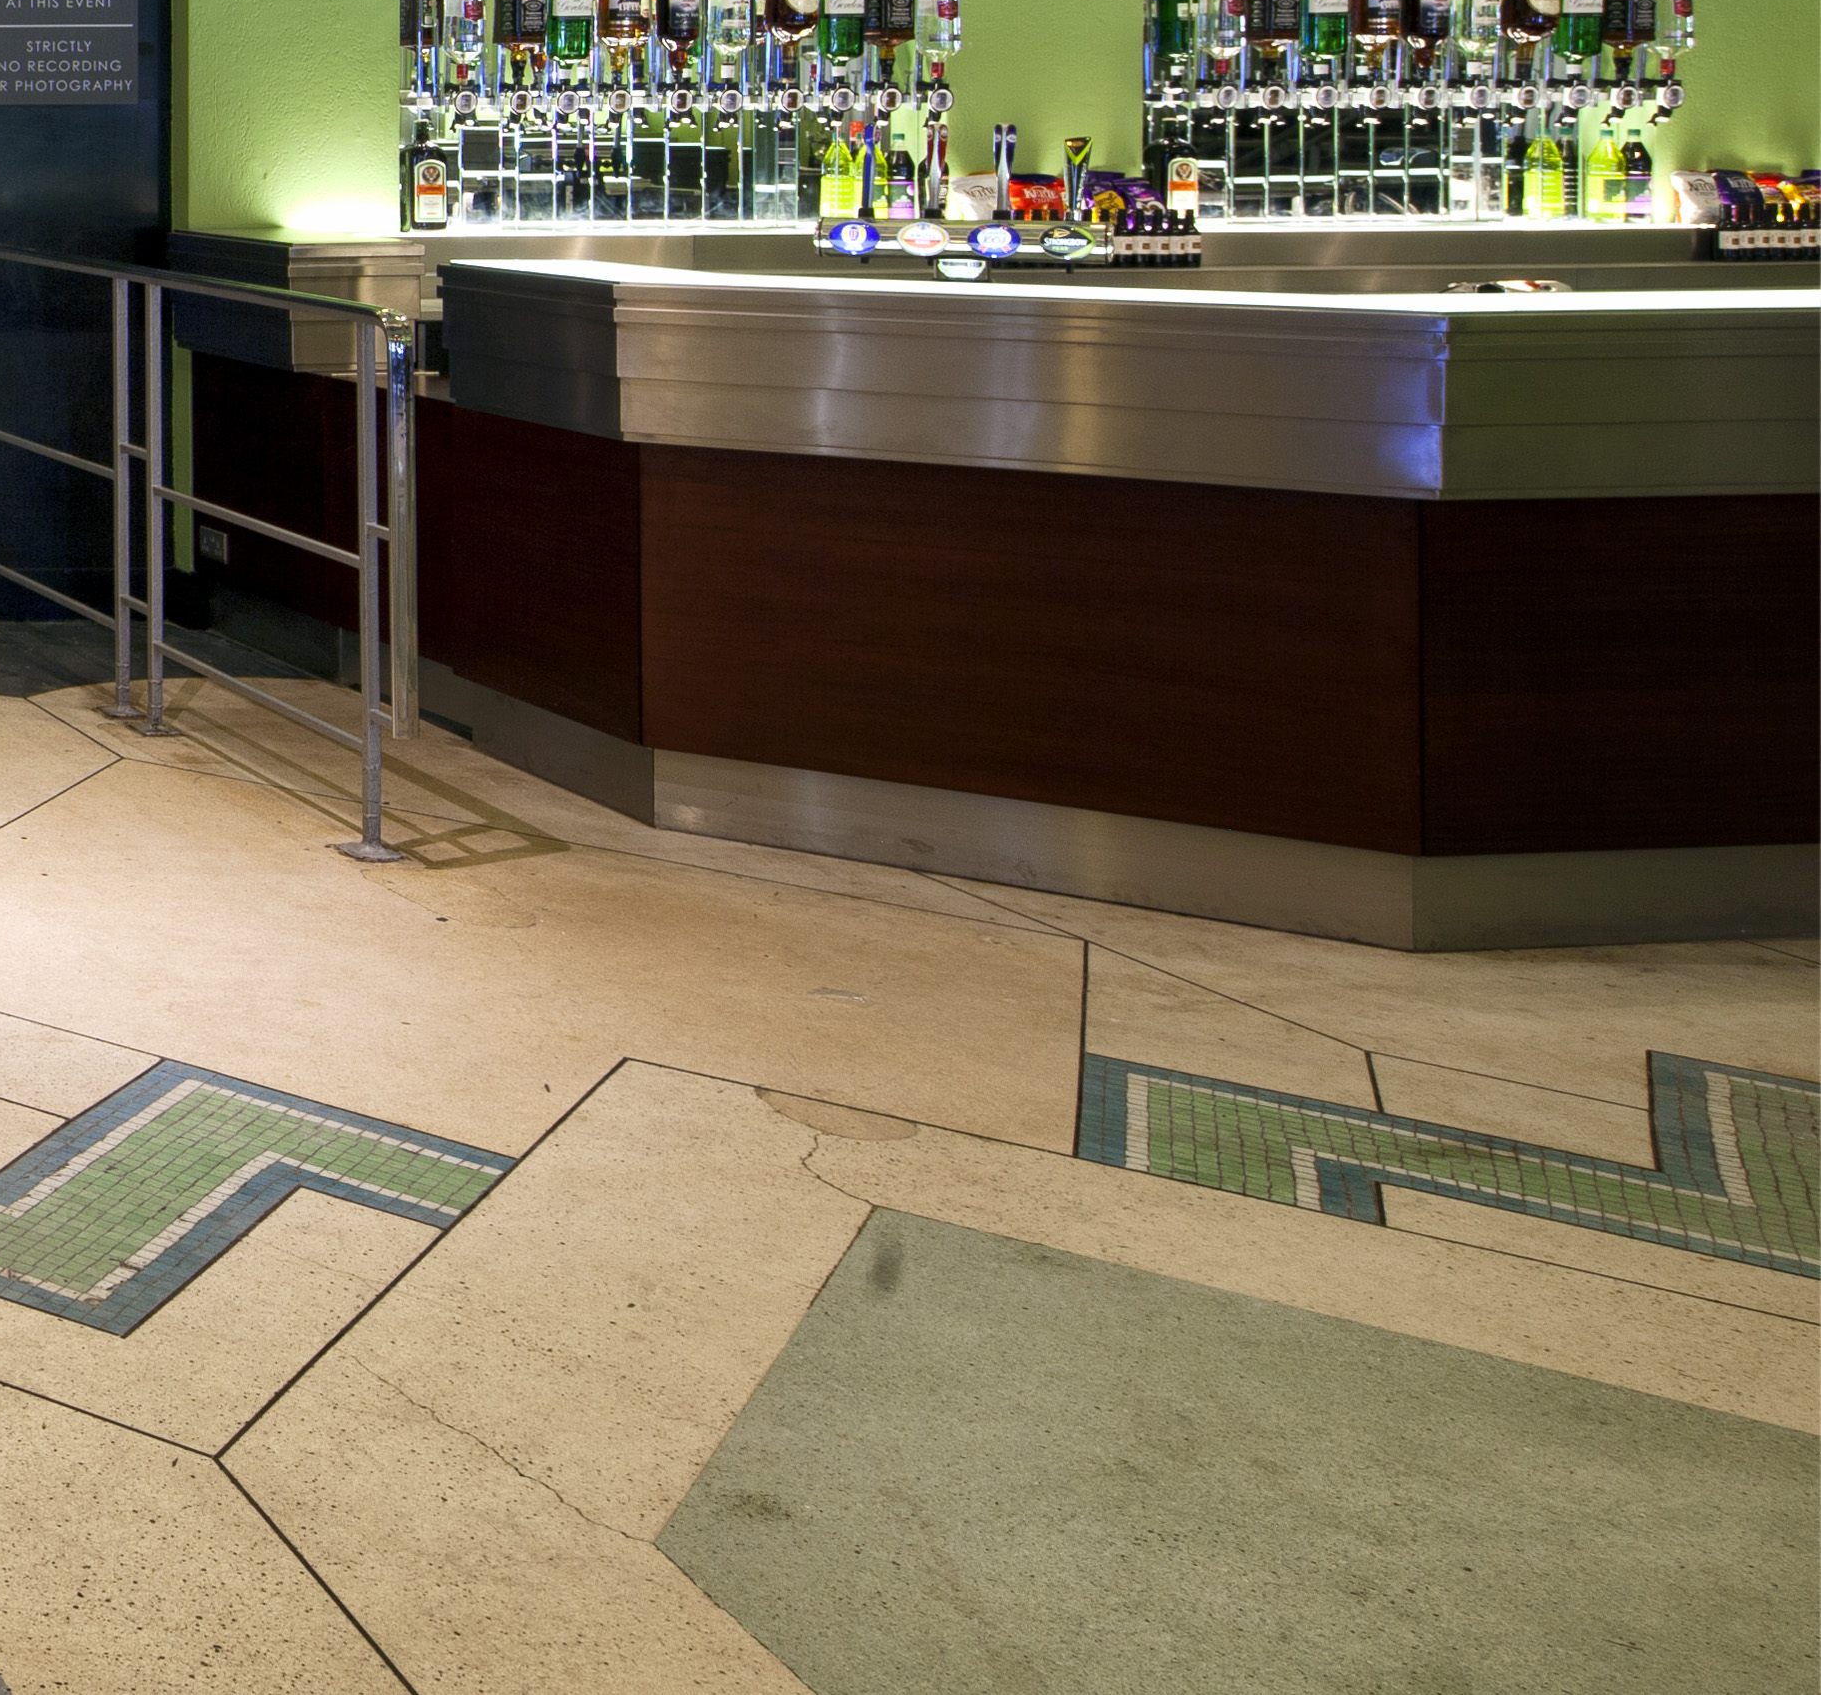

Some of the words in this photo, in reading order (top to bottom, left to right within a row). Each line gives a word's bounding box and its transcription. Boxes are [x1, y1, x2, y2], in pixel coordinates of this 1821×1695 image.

[26, 40, 92, 53] STRICTLY
[27, 60, 123, 72] RECORDING
[15, 79, 133, 92] PHOTOGRAPHY
